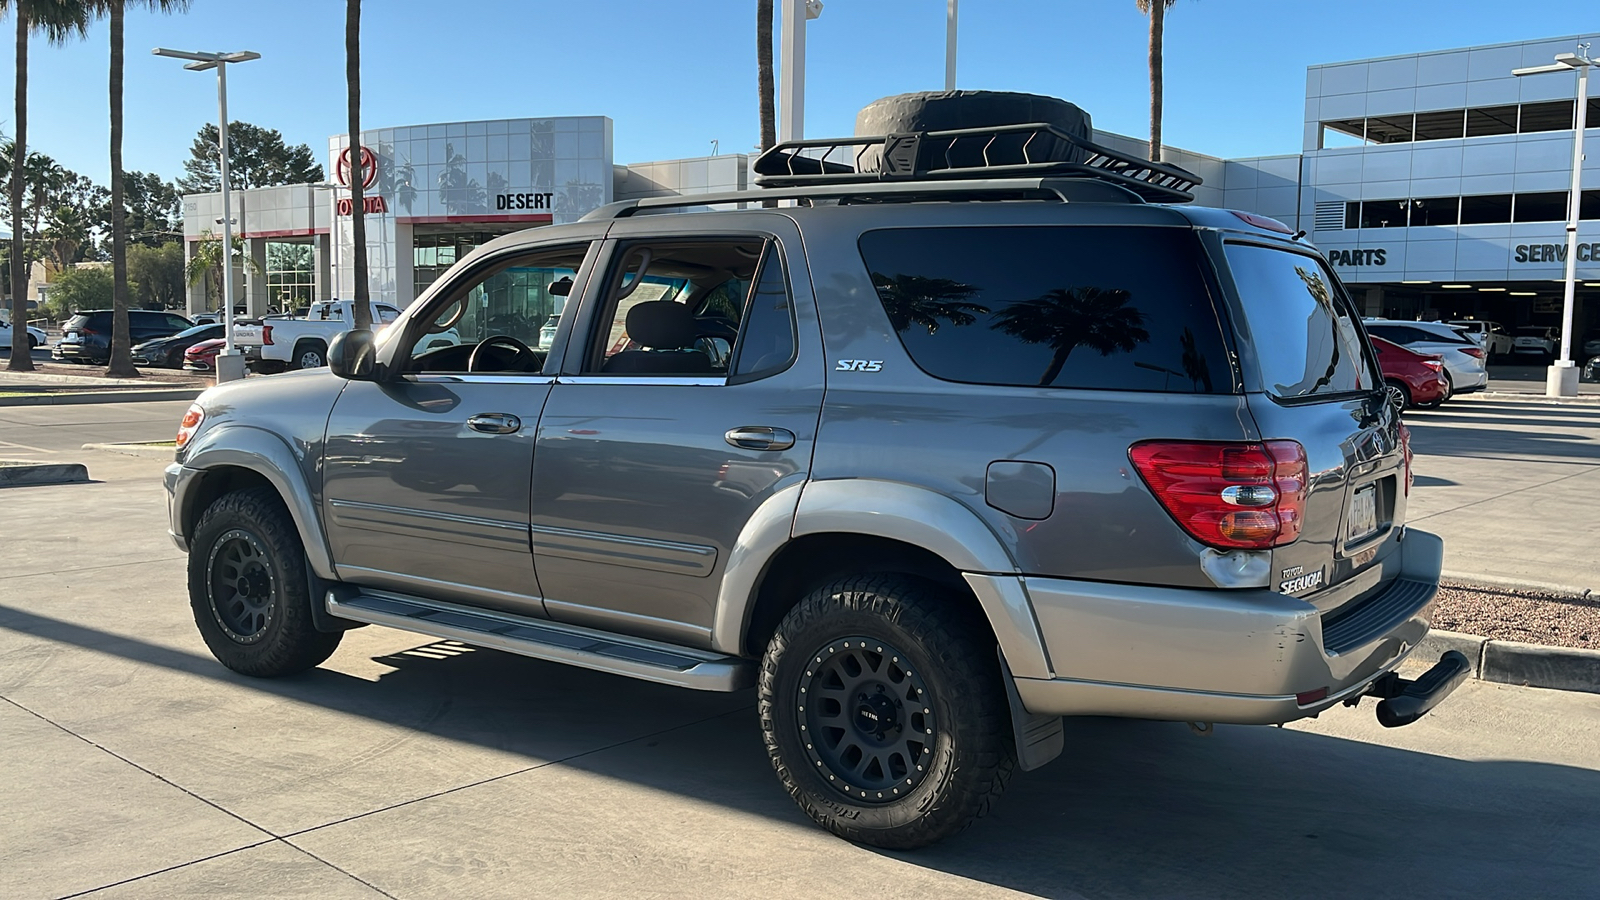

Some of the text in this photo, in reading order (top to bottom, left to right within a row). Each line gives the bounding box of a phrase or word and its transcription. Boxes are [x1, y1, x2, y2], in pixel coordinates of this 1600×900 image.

[336, 196, 386, 216] OTA
[496, 193, 554, 210] DESERT
[1328, 248, 1387, 267] PARTS
[1514, 243, 1600, 263] SERVCE
[835, 359, 884, 372] SR5
[1282, 565, 1303, 579] TOYOTA
[1279, 570, 1323, 595] SEQUOIA
